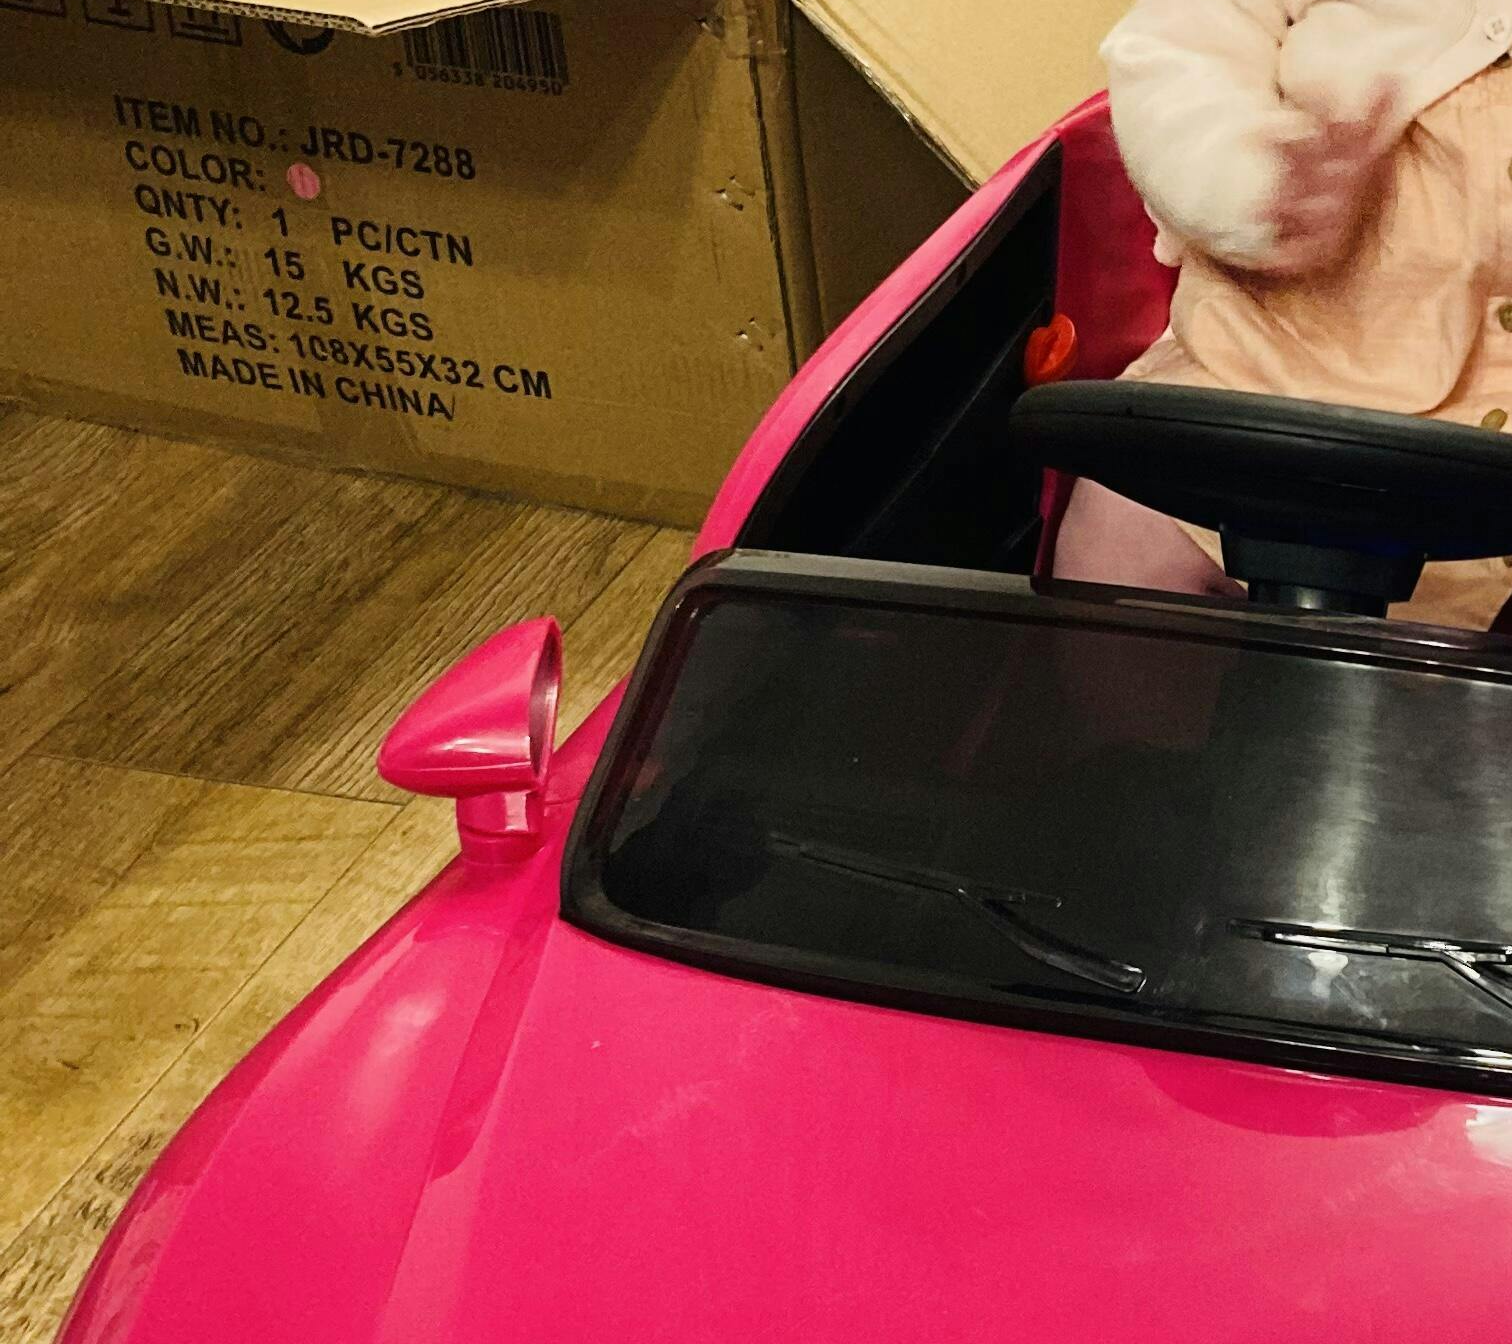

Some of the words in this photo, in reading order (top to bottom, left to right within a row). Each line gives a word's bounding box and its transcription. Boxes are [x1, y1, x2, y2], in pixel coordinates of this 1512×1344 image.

[113, 94, 200, 137] ITEM
[300, 125, 477, 181] JRD-7288
[124, 139, 266, 192] COLOR:
[134, 183, 243, 229] QNTY:
[271, 207, 289, 237] 1
[330, 216, 474, 267] PC/CTN
[145, 226, 237, 268] G.W.:
[263, 247, 305, 281] 15
[342, 260, 425, 299] KGS
[153, 267, 245, 311] N.W.:
[262, 287, 334, 325] 12.5
[351, 301, 434, 341] KGS
[164, 307, 281, 354] MEAS:
[288, 332, 484, 389] 108X55X32
[493, 364, 552, 400] CM
[176, 347, 283, 390] MADE
[287, 367, 327, 399] IN
[334, 376, 455, 422] CHINA
